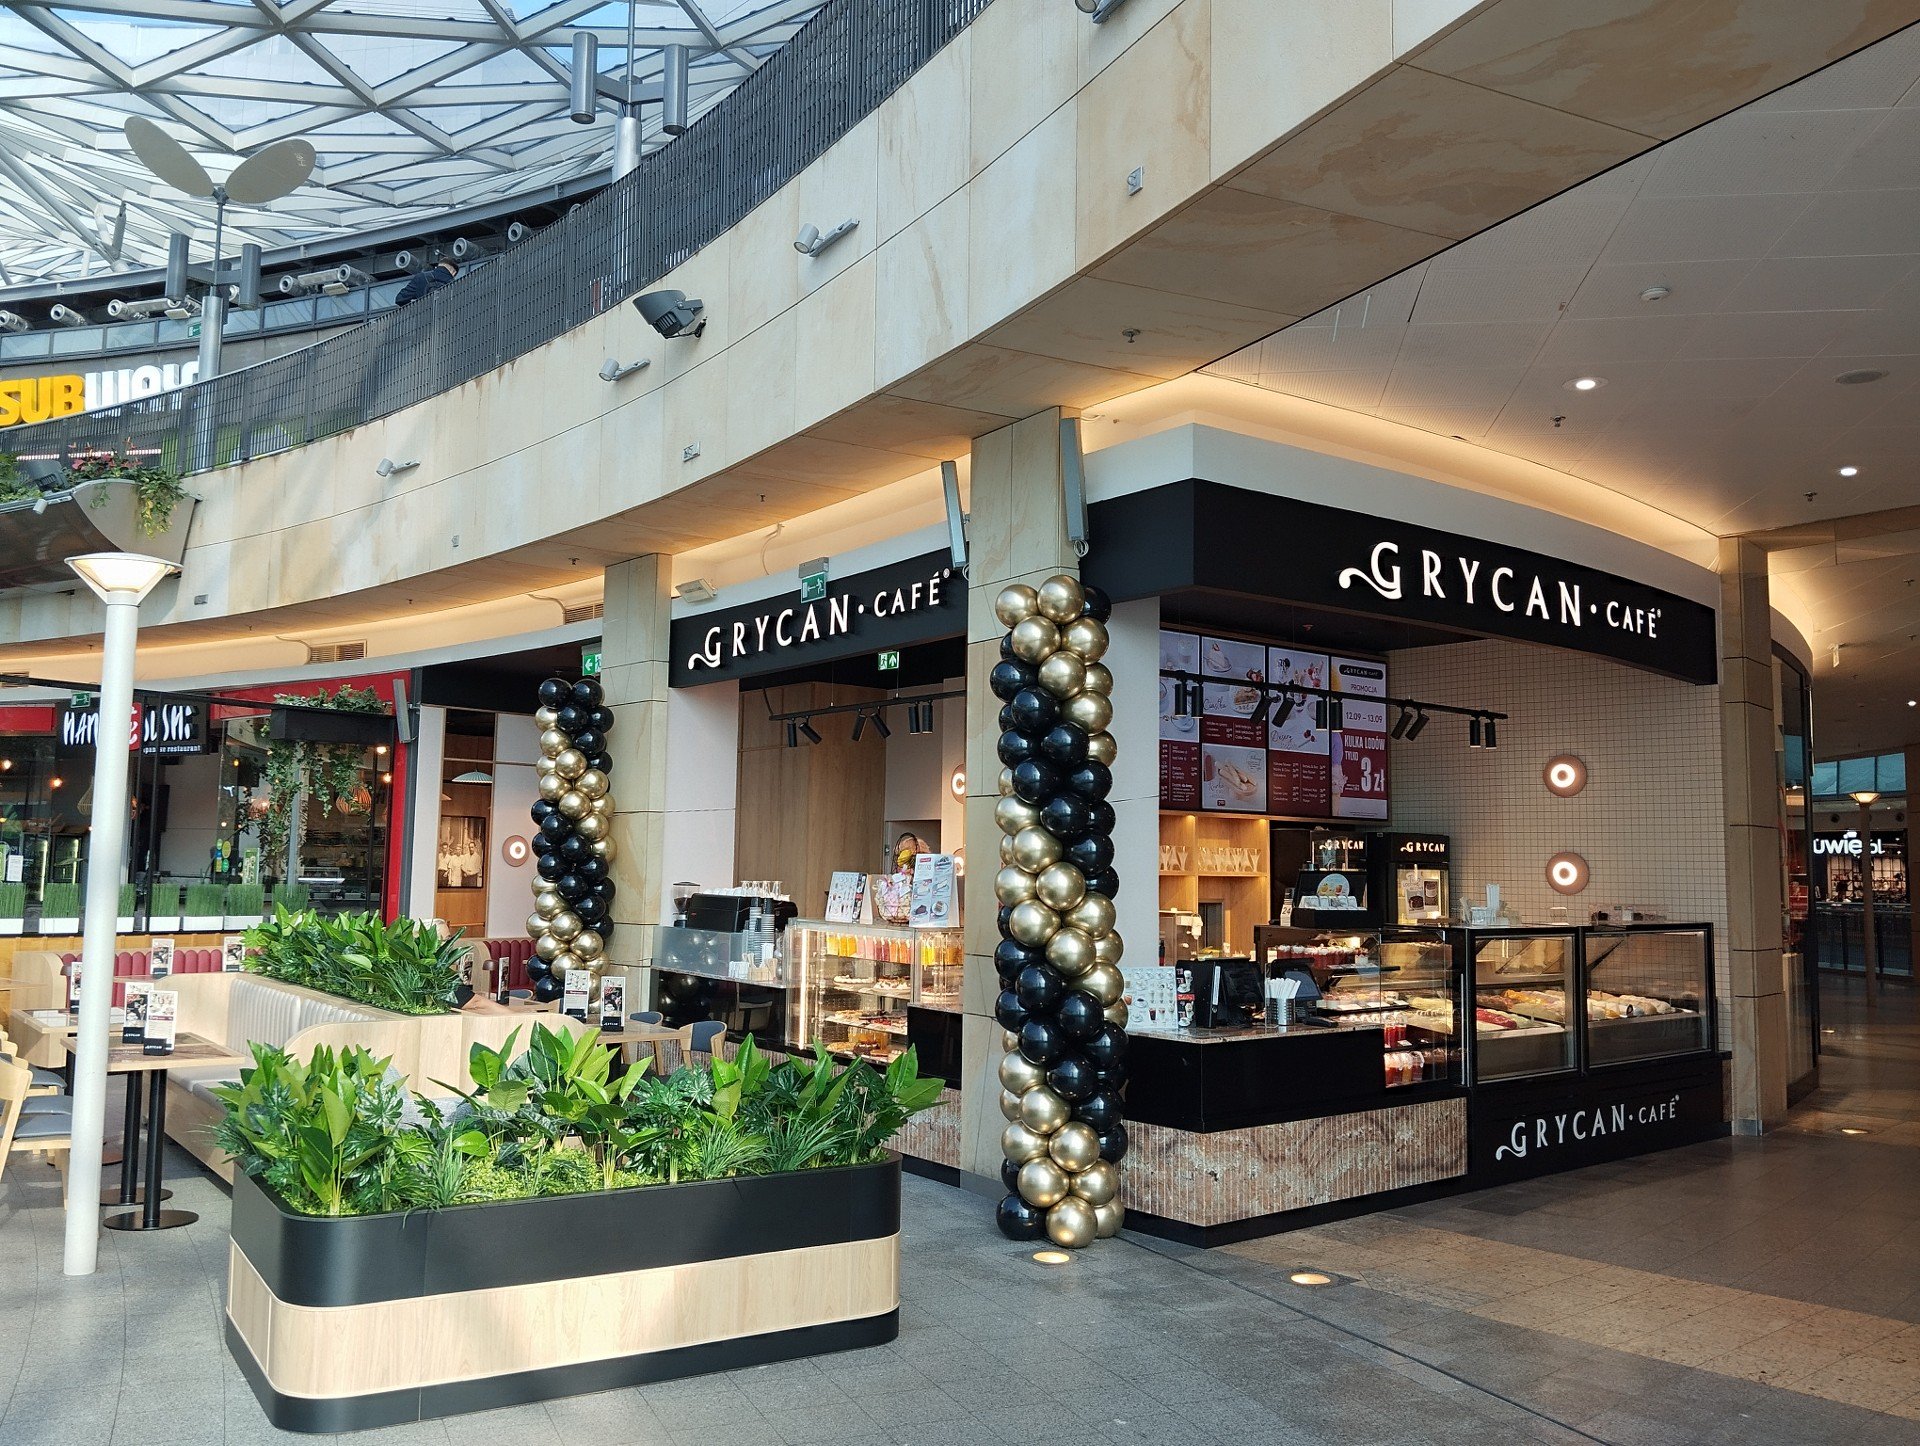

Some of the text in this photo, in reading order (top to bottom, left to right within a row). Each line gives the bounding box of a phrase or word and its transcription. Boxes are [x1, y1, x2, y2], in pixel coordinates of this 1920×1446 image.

[1339, 541, 1582, 627] GRYCAN
[687, 593, 850, 670] GRYCAN
[1345, 711, 1361, 721] 12.09
[1367, 714, 1383, 724] 13.09
[166, 744, 201, 753] restaurant
[1344, 734, 1386, 751] KULKA LODÓW
[1361, 756, 1372, 793] 3
[1373, 768, 1386, 792] zł
[1400, 841, 1446, 854] GRYCAN
[1495, 1103, 1625, 1161] GRYCAN
